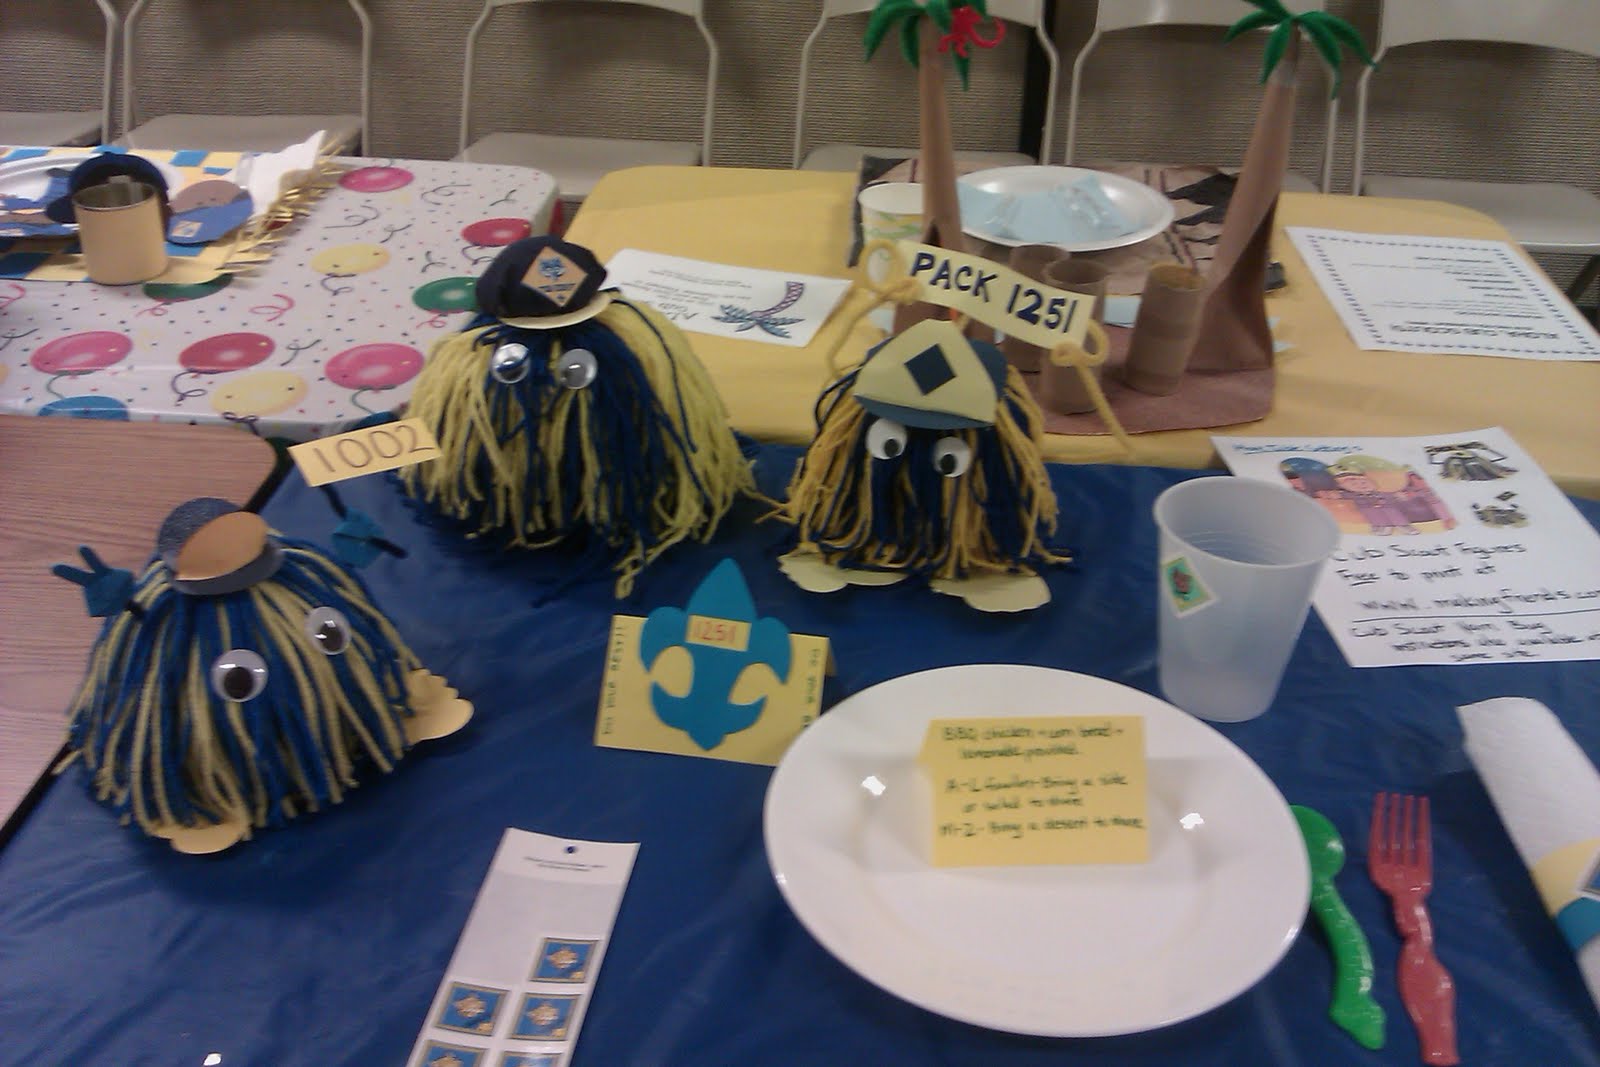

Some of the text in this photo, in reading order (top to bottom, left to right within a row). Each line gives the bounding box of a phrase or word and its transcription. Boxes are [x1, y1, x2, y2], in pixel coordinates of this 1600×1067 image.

[910, 252, 1079, 333] PACK 1251
[314, 424, 436, 473] 1002
[693, 619, 738, 642] 1251
